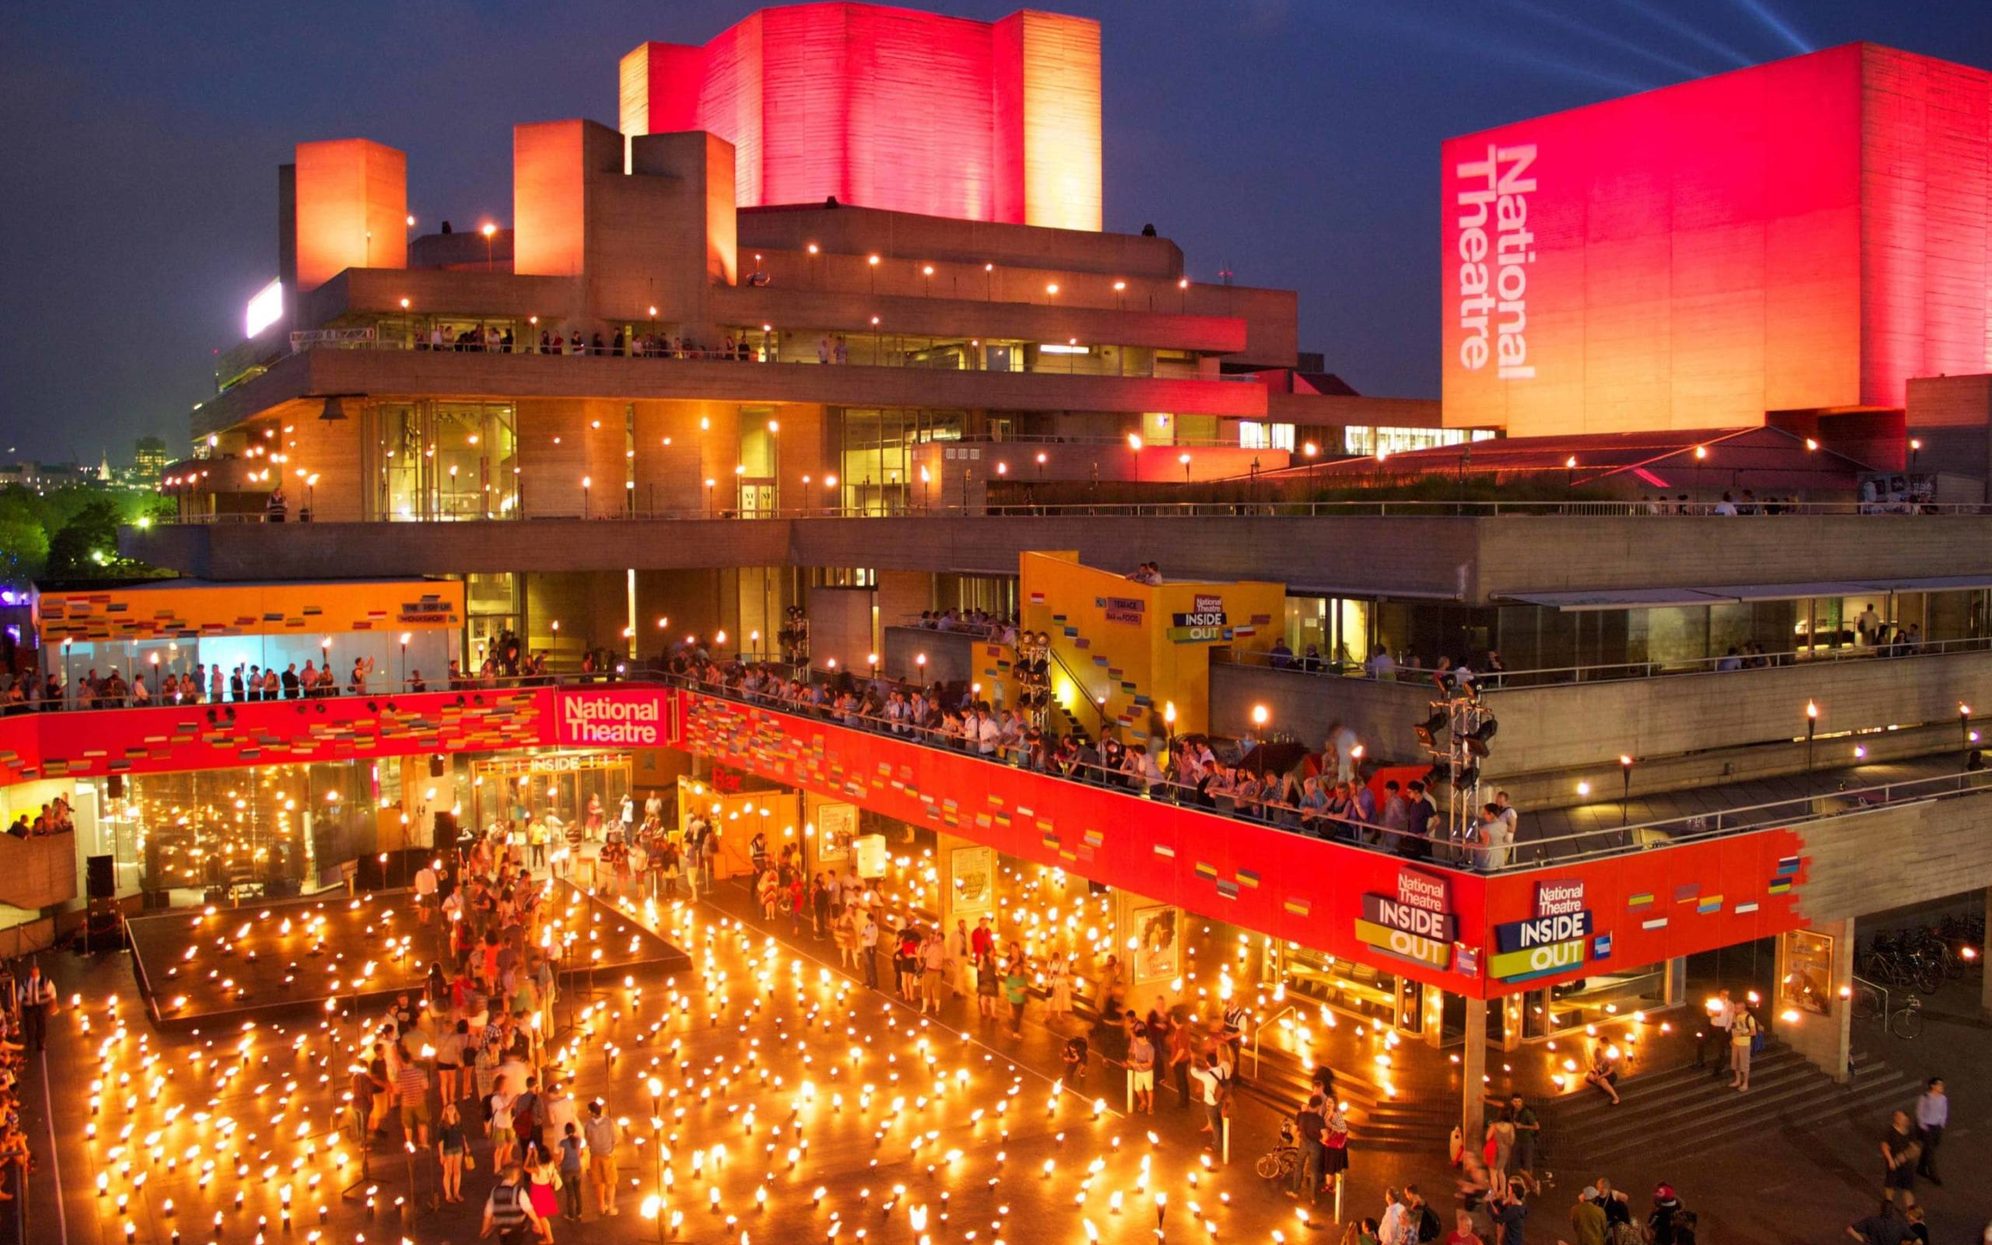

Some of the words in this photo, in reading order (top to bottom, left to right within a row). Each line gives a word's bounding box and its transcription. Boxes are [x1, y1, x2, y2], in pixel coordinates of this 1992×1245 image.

[1457, 144, 1496, 370] Theatre
[1497, 144, 1537, 378] National
[1185, 613, 1221, 625] INSIDE
[1190, 628, 1218, 639] OUT
[564, 696, 659, 721] National
[566, 718, 656, 743] Theatre
[530, 757, 580, 772] INSIDE
[712, 767, 741, 791] Bar
[1398, 873, 1444, 898] National
[1539, 883, 1583, 902] National
[1399, 888, 1442, 911] Theatre
[1540, 900, 1581, 916] Theatre
[1379, 899, 1444, 939] INSIDE
[1520, 912, 1585, 948] INSIDE
[1390, 930, 1443, 964] OUT
[1530, 940, 1583, 971] OUT
